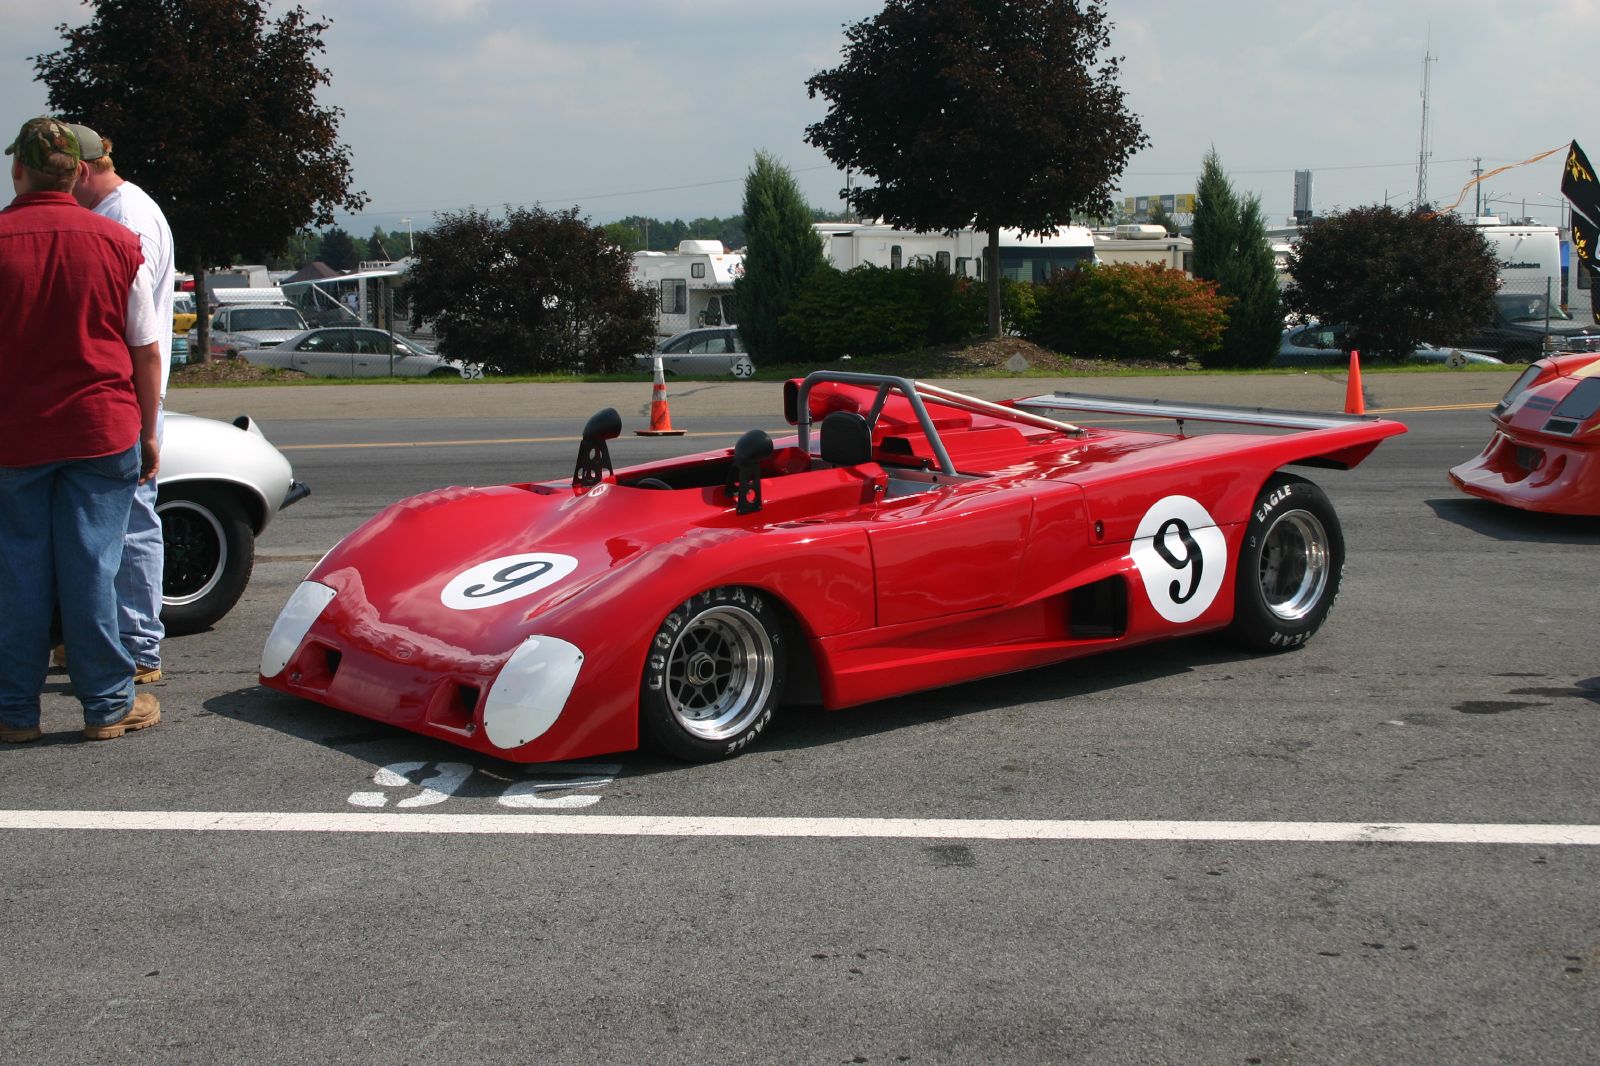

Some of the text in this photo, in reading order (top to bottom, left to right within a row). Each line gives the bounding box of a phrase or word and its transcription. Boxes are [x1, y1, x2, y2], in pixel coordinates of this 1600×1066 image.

[463, 368, 480, 379] 52
[735, 364, 752, 376] 53
[1256, 485, 1292, 523] EAGLE
[463, 561, 553, 598] 9
[1153, 518, 1203, 604] 9
[725, 709, 772, 755] EAGLE
